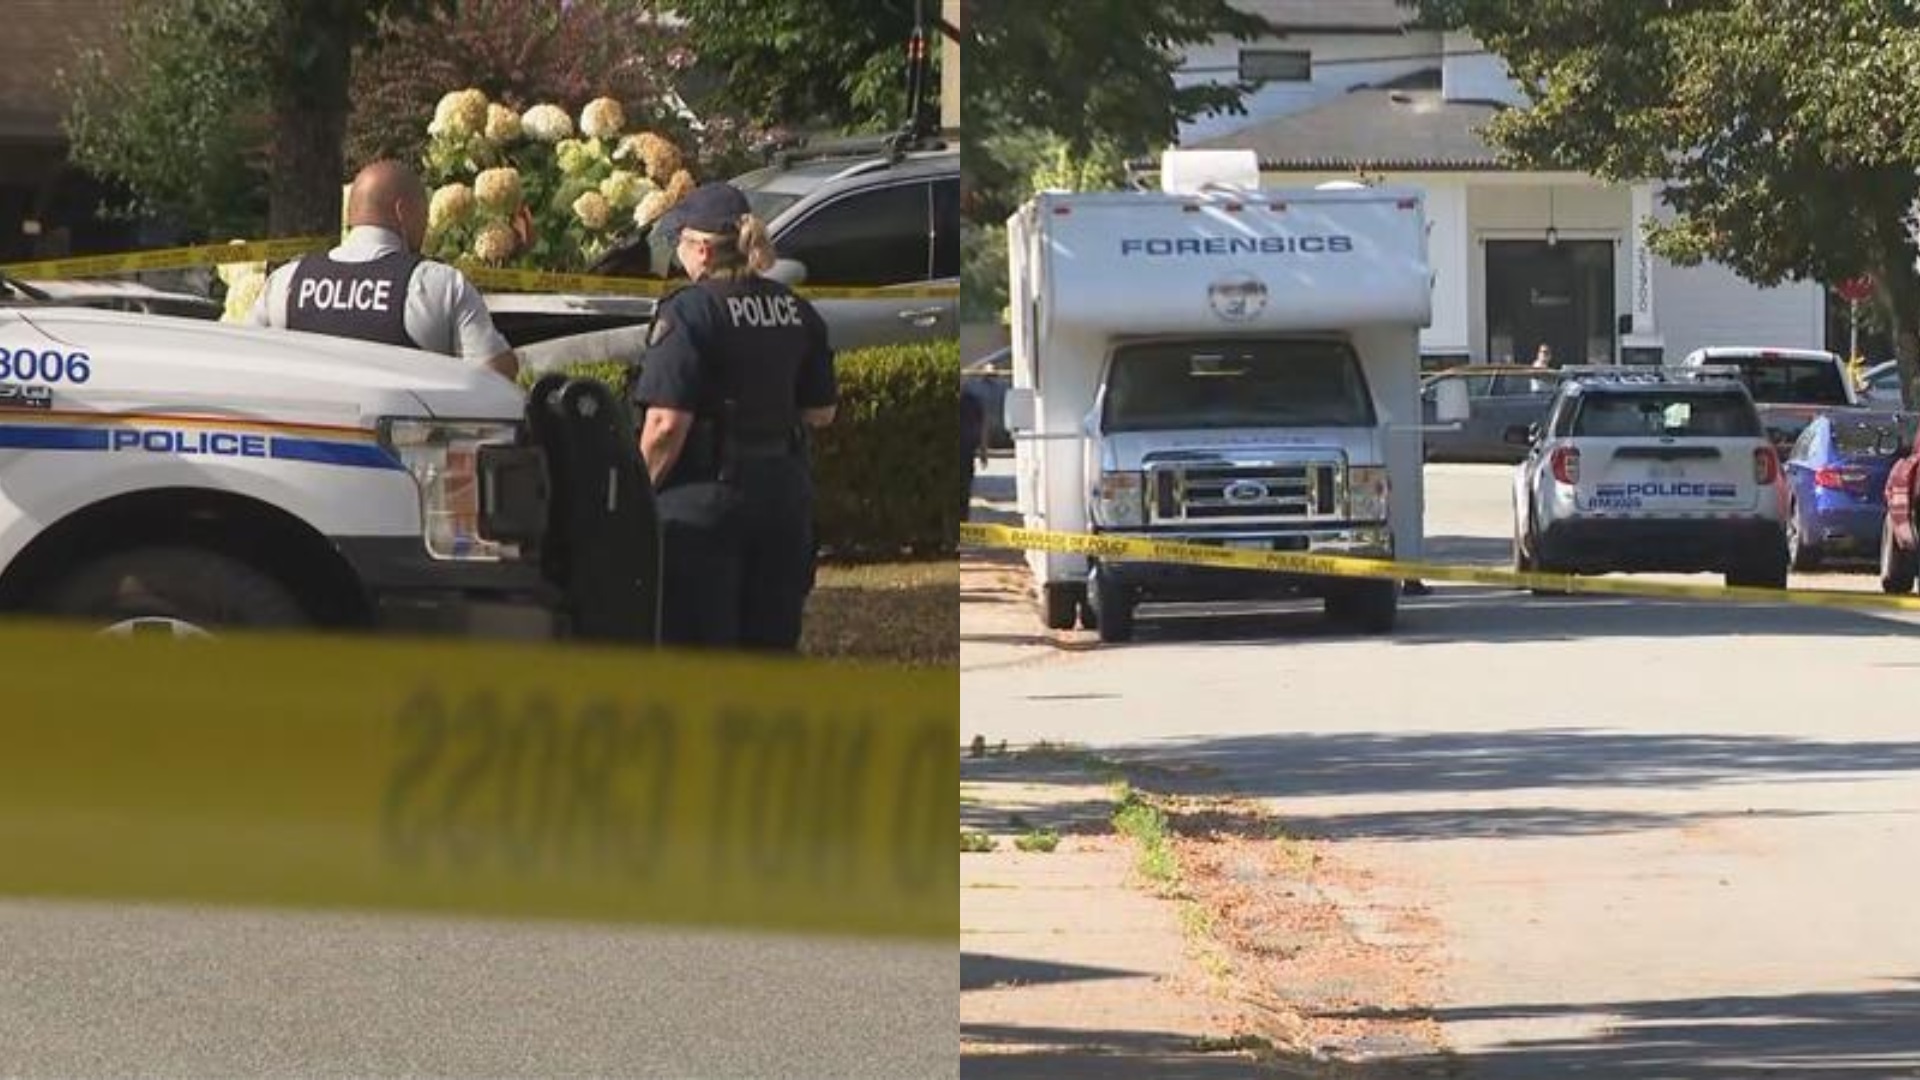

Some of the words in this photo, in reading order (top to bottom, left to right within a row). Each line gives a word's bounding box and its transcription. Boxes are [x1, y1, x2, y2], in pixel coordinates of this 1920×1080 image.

[1121, 235, 1354, 256] FORENSICS
[299, 278, 392, 311] POLICE
[727, 294, 802, 327] POLICE
[113, 429, 265, 457] POLICE
[1627, 483, 1705, 497] POLICE
